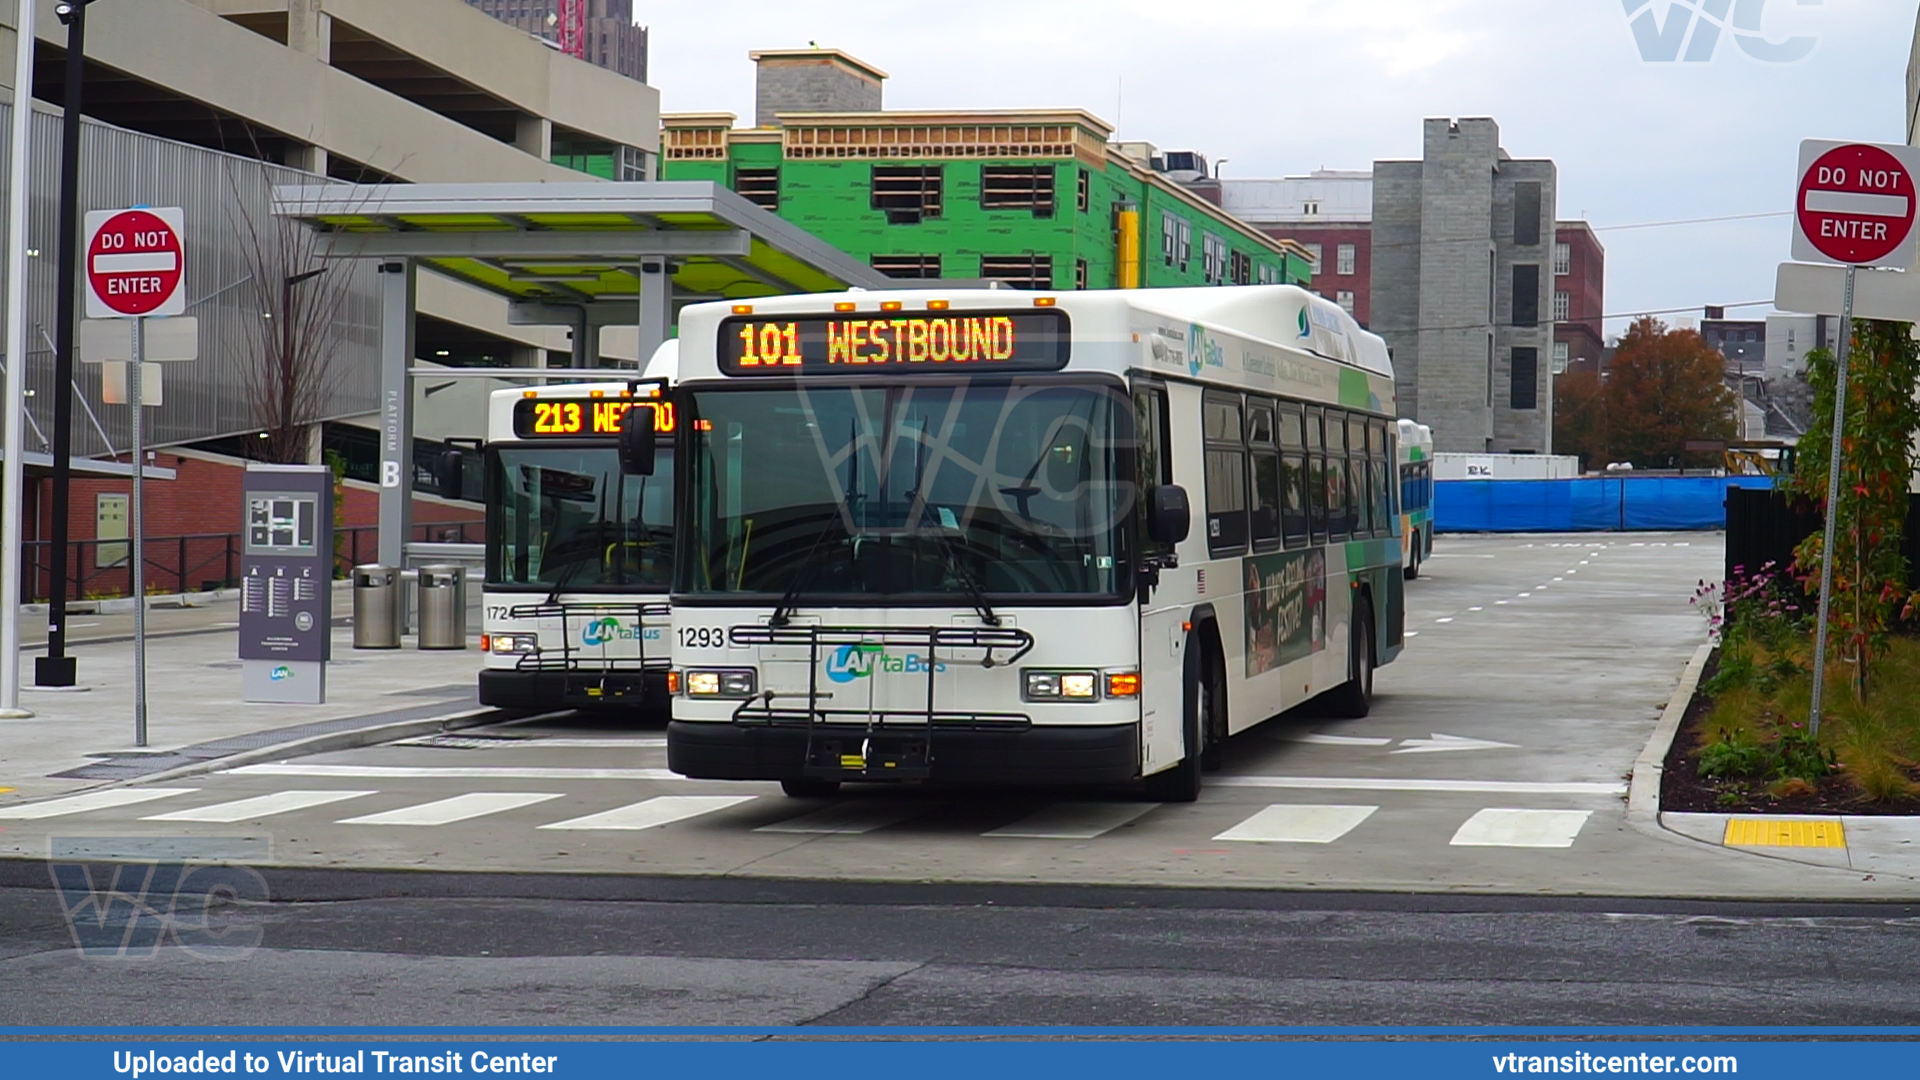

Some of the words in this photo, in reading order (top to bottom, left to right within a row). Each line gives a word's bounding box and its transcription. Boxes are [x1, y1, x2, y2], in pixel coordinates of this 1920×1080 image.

[1818, 166, 1846, 186] DO
[1858, 169, 1901, 190] NOT
[102, 233, 125, 249] DO
[134, 231, 168, 248] NOT
[1820, 219, 1887, 241] ENTER
[108, 277, 161, 295] ENTER
[740, 322, 802, 365] 101
[828, 317, 1013, 364] WESTBOUND
[387, 390, 398, 451] PLATFORM
[534, 402, 581, 433] 213
[382, 461, 400, 488] B
[487, 606, 513, 620] 172
[677, 627, 724, 648] 1293
